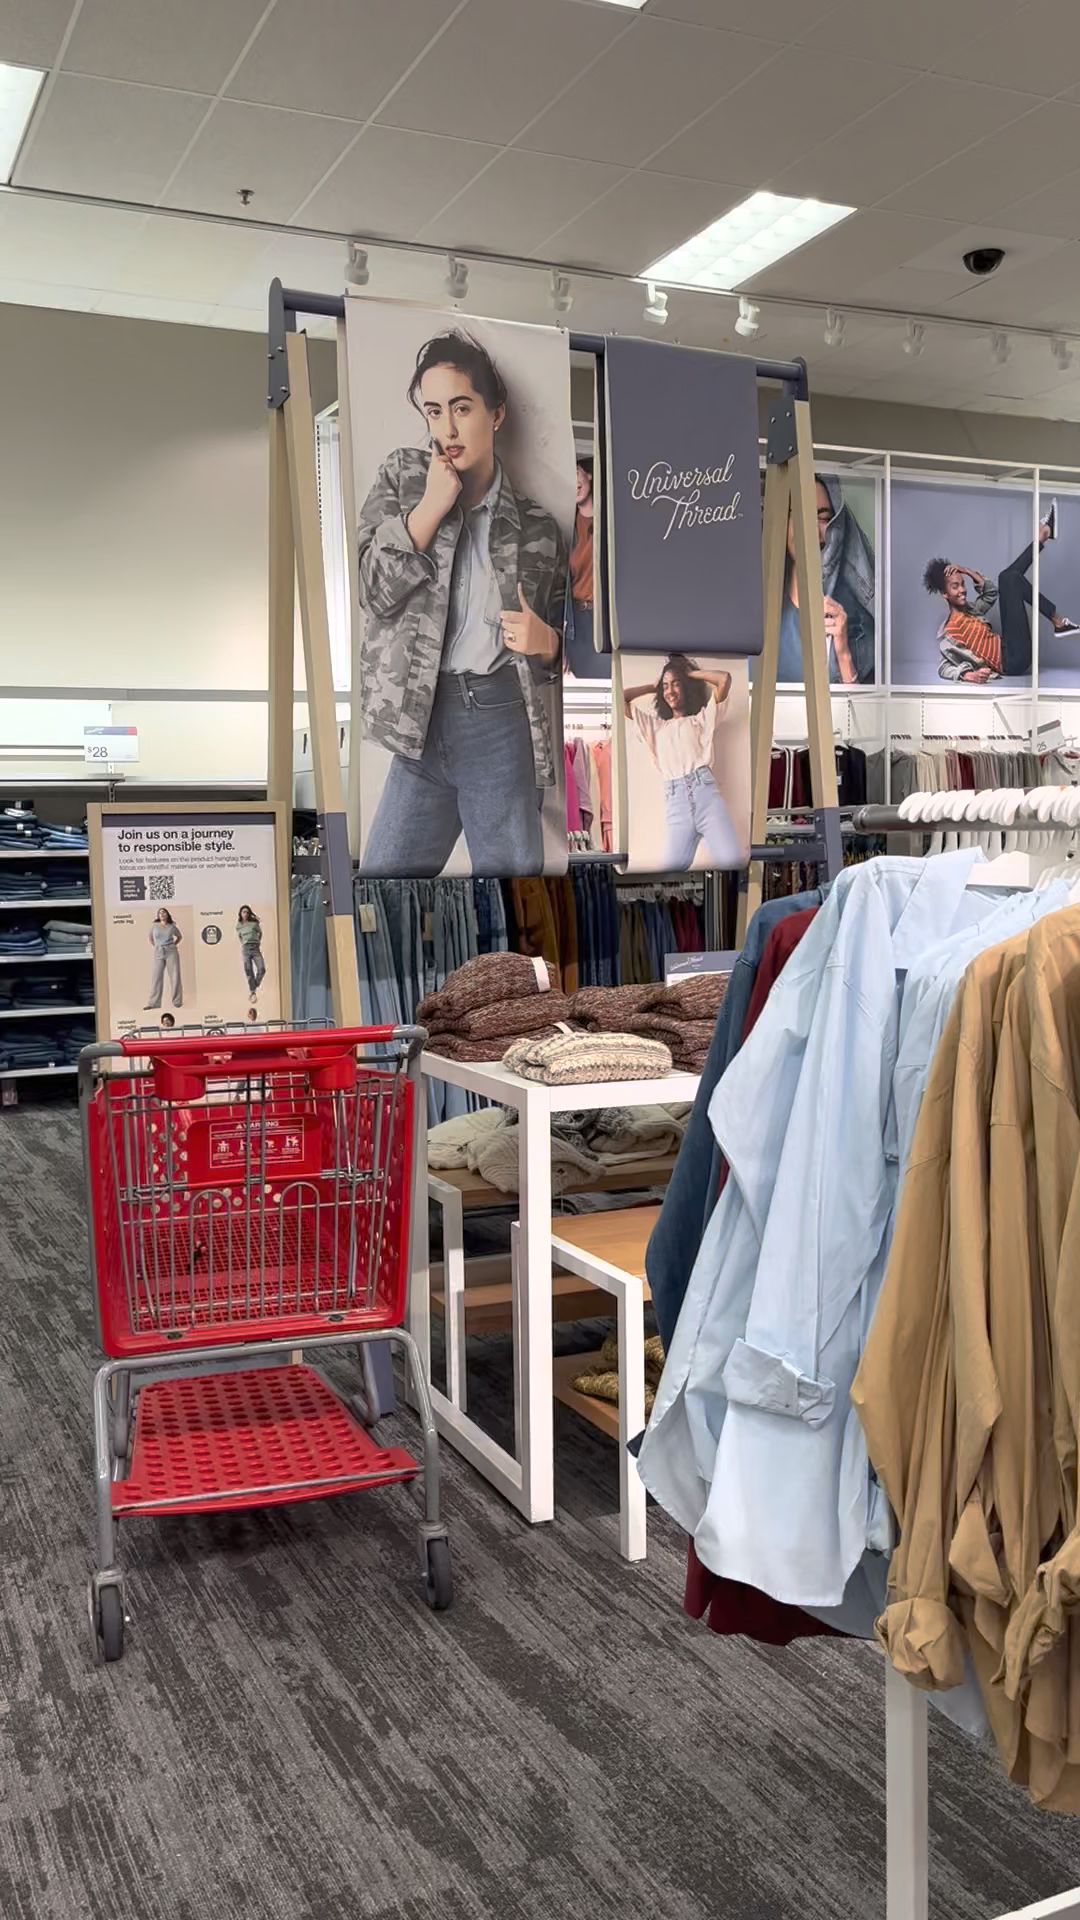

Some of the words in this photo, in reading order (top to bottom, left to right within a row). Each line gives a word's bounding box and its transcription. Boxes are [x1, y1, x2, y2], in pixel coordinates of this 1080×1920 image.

[628, 454, 735, 500] Universal
[651, 489, 741, 540] Thread
[87, 746, 108, 758] $28
[117, 829, 142, 840] Join
[146, 831, 160, 839] us
[163, 831, 178, 839] on
[181, 831, 188, 839] a
[191, 828, 234, 840] journey
[118, 843, 131, 852] to
[134, 841, 201, 853] responsible
[204, 840, 235, 853] style.
